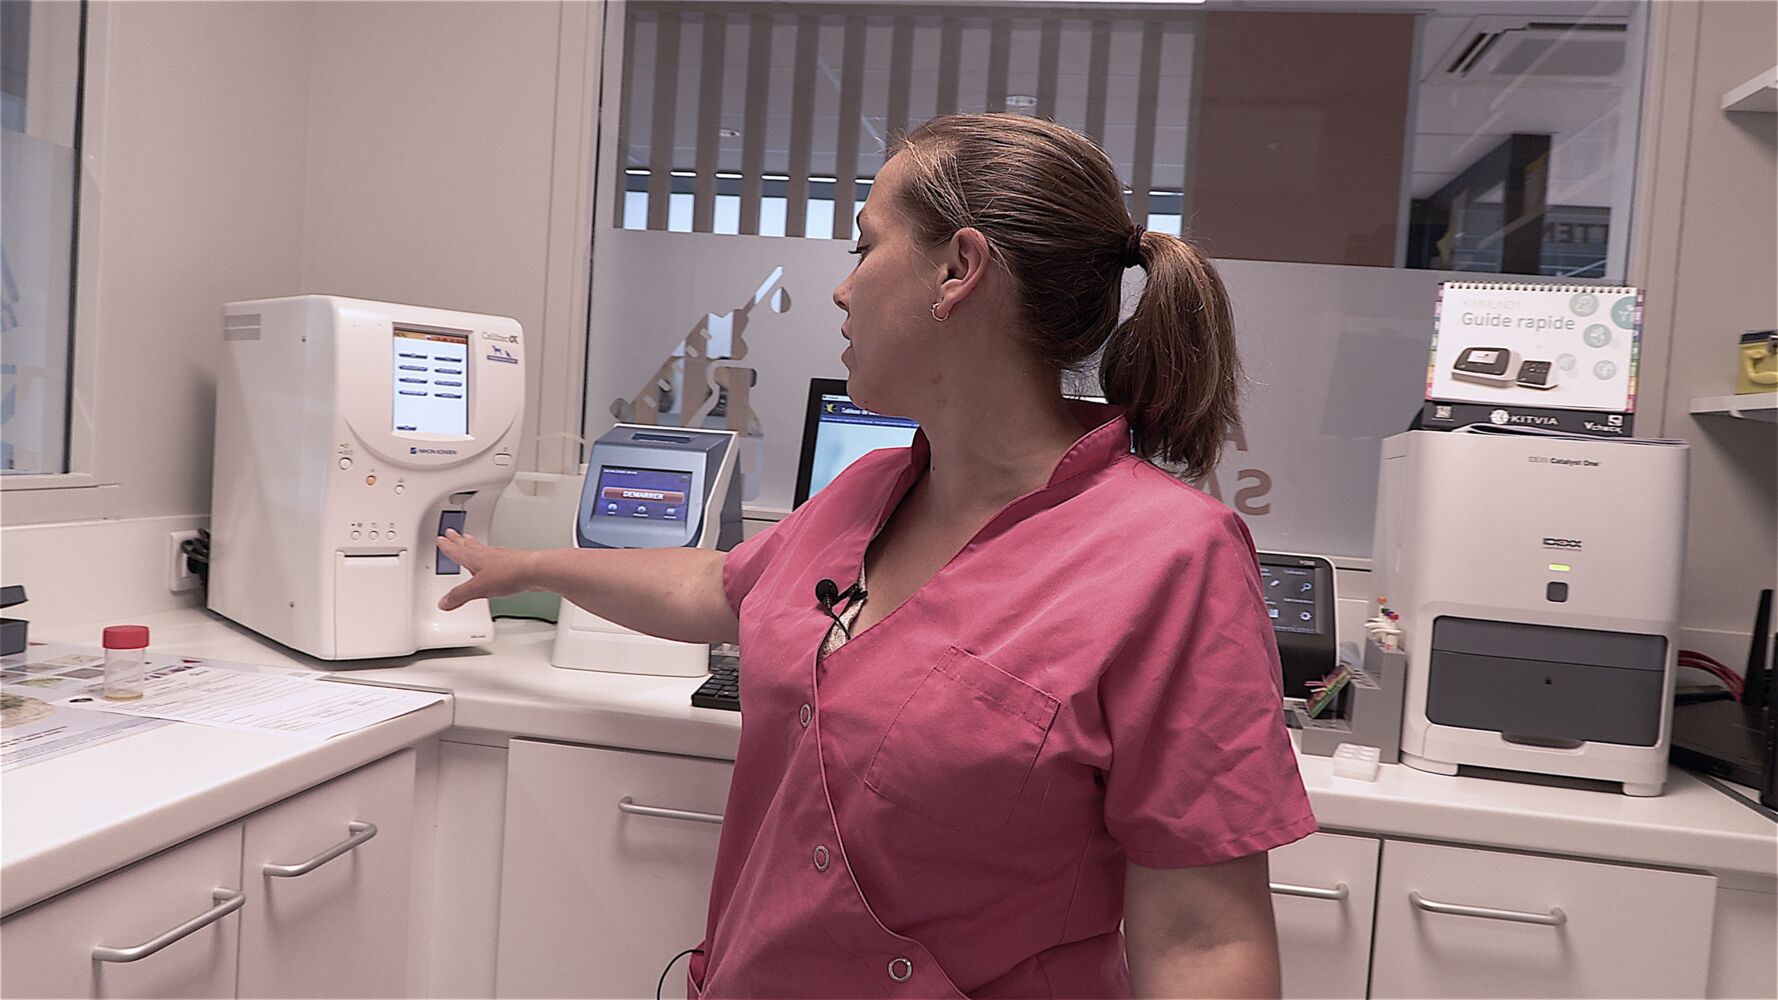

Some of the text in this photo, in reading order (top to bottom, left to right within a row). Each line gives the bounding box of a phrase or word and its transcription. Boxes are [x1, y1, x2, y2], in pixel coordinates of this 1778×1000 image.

[1462, 312, 1576, 332] Guide rapide
[1510, 415, 1559, 426] KITVIA
[1551, 457, 1581, 467] Catalyst
